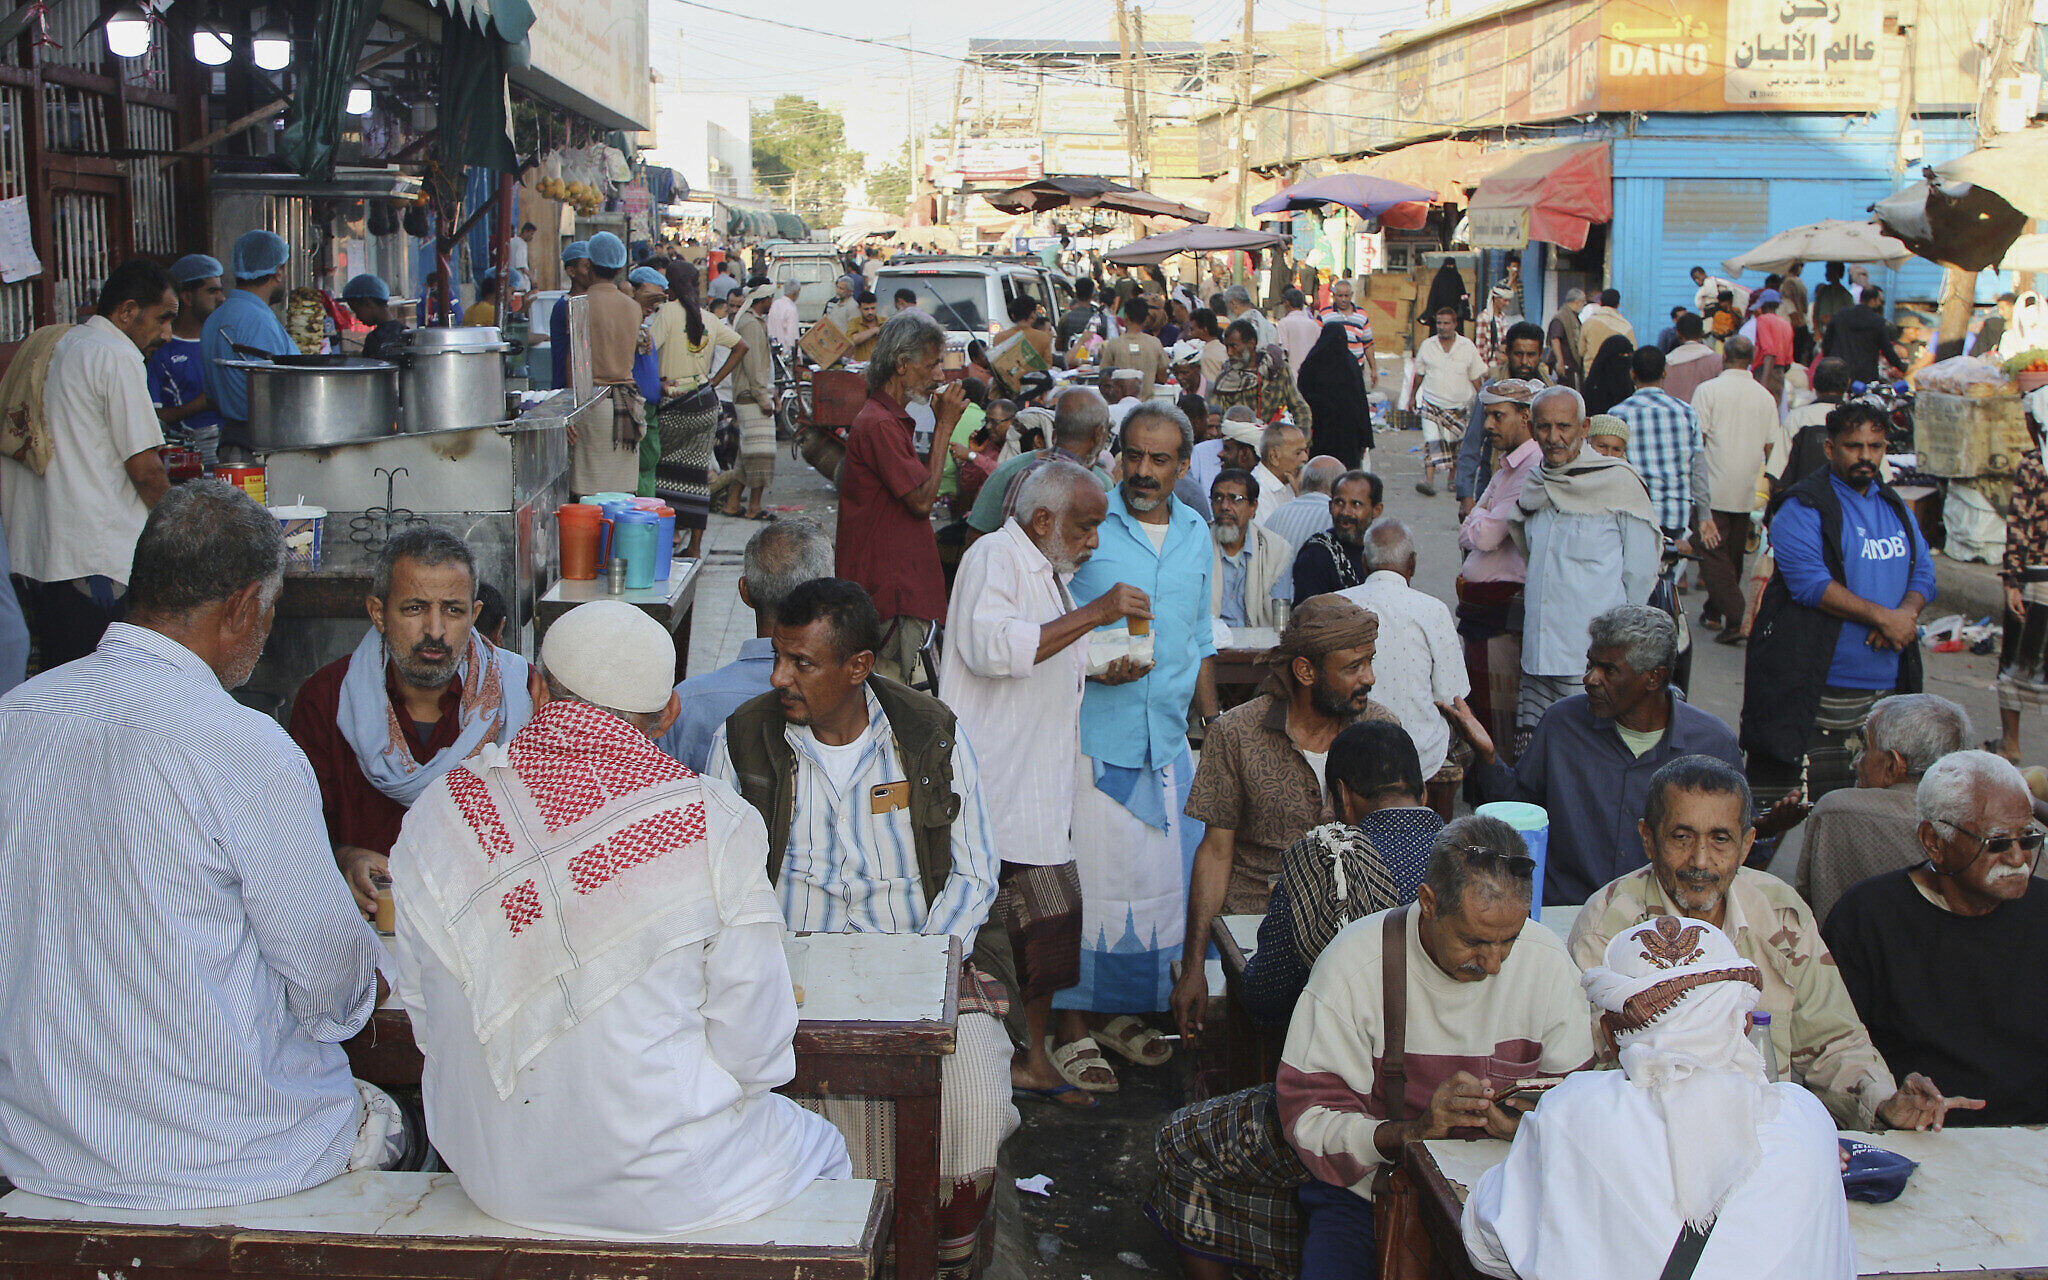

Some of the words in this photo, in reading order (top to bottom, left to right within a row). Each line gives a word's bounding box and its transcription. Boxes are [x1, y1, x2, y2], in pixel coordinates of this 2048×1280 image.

[1780, 0, 1840, 25] ركن
[1609, 43, 1709, 77] DANO
[1823, 32, 1876, 71] عالم
